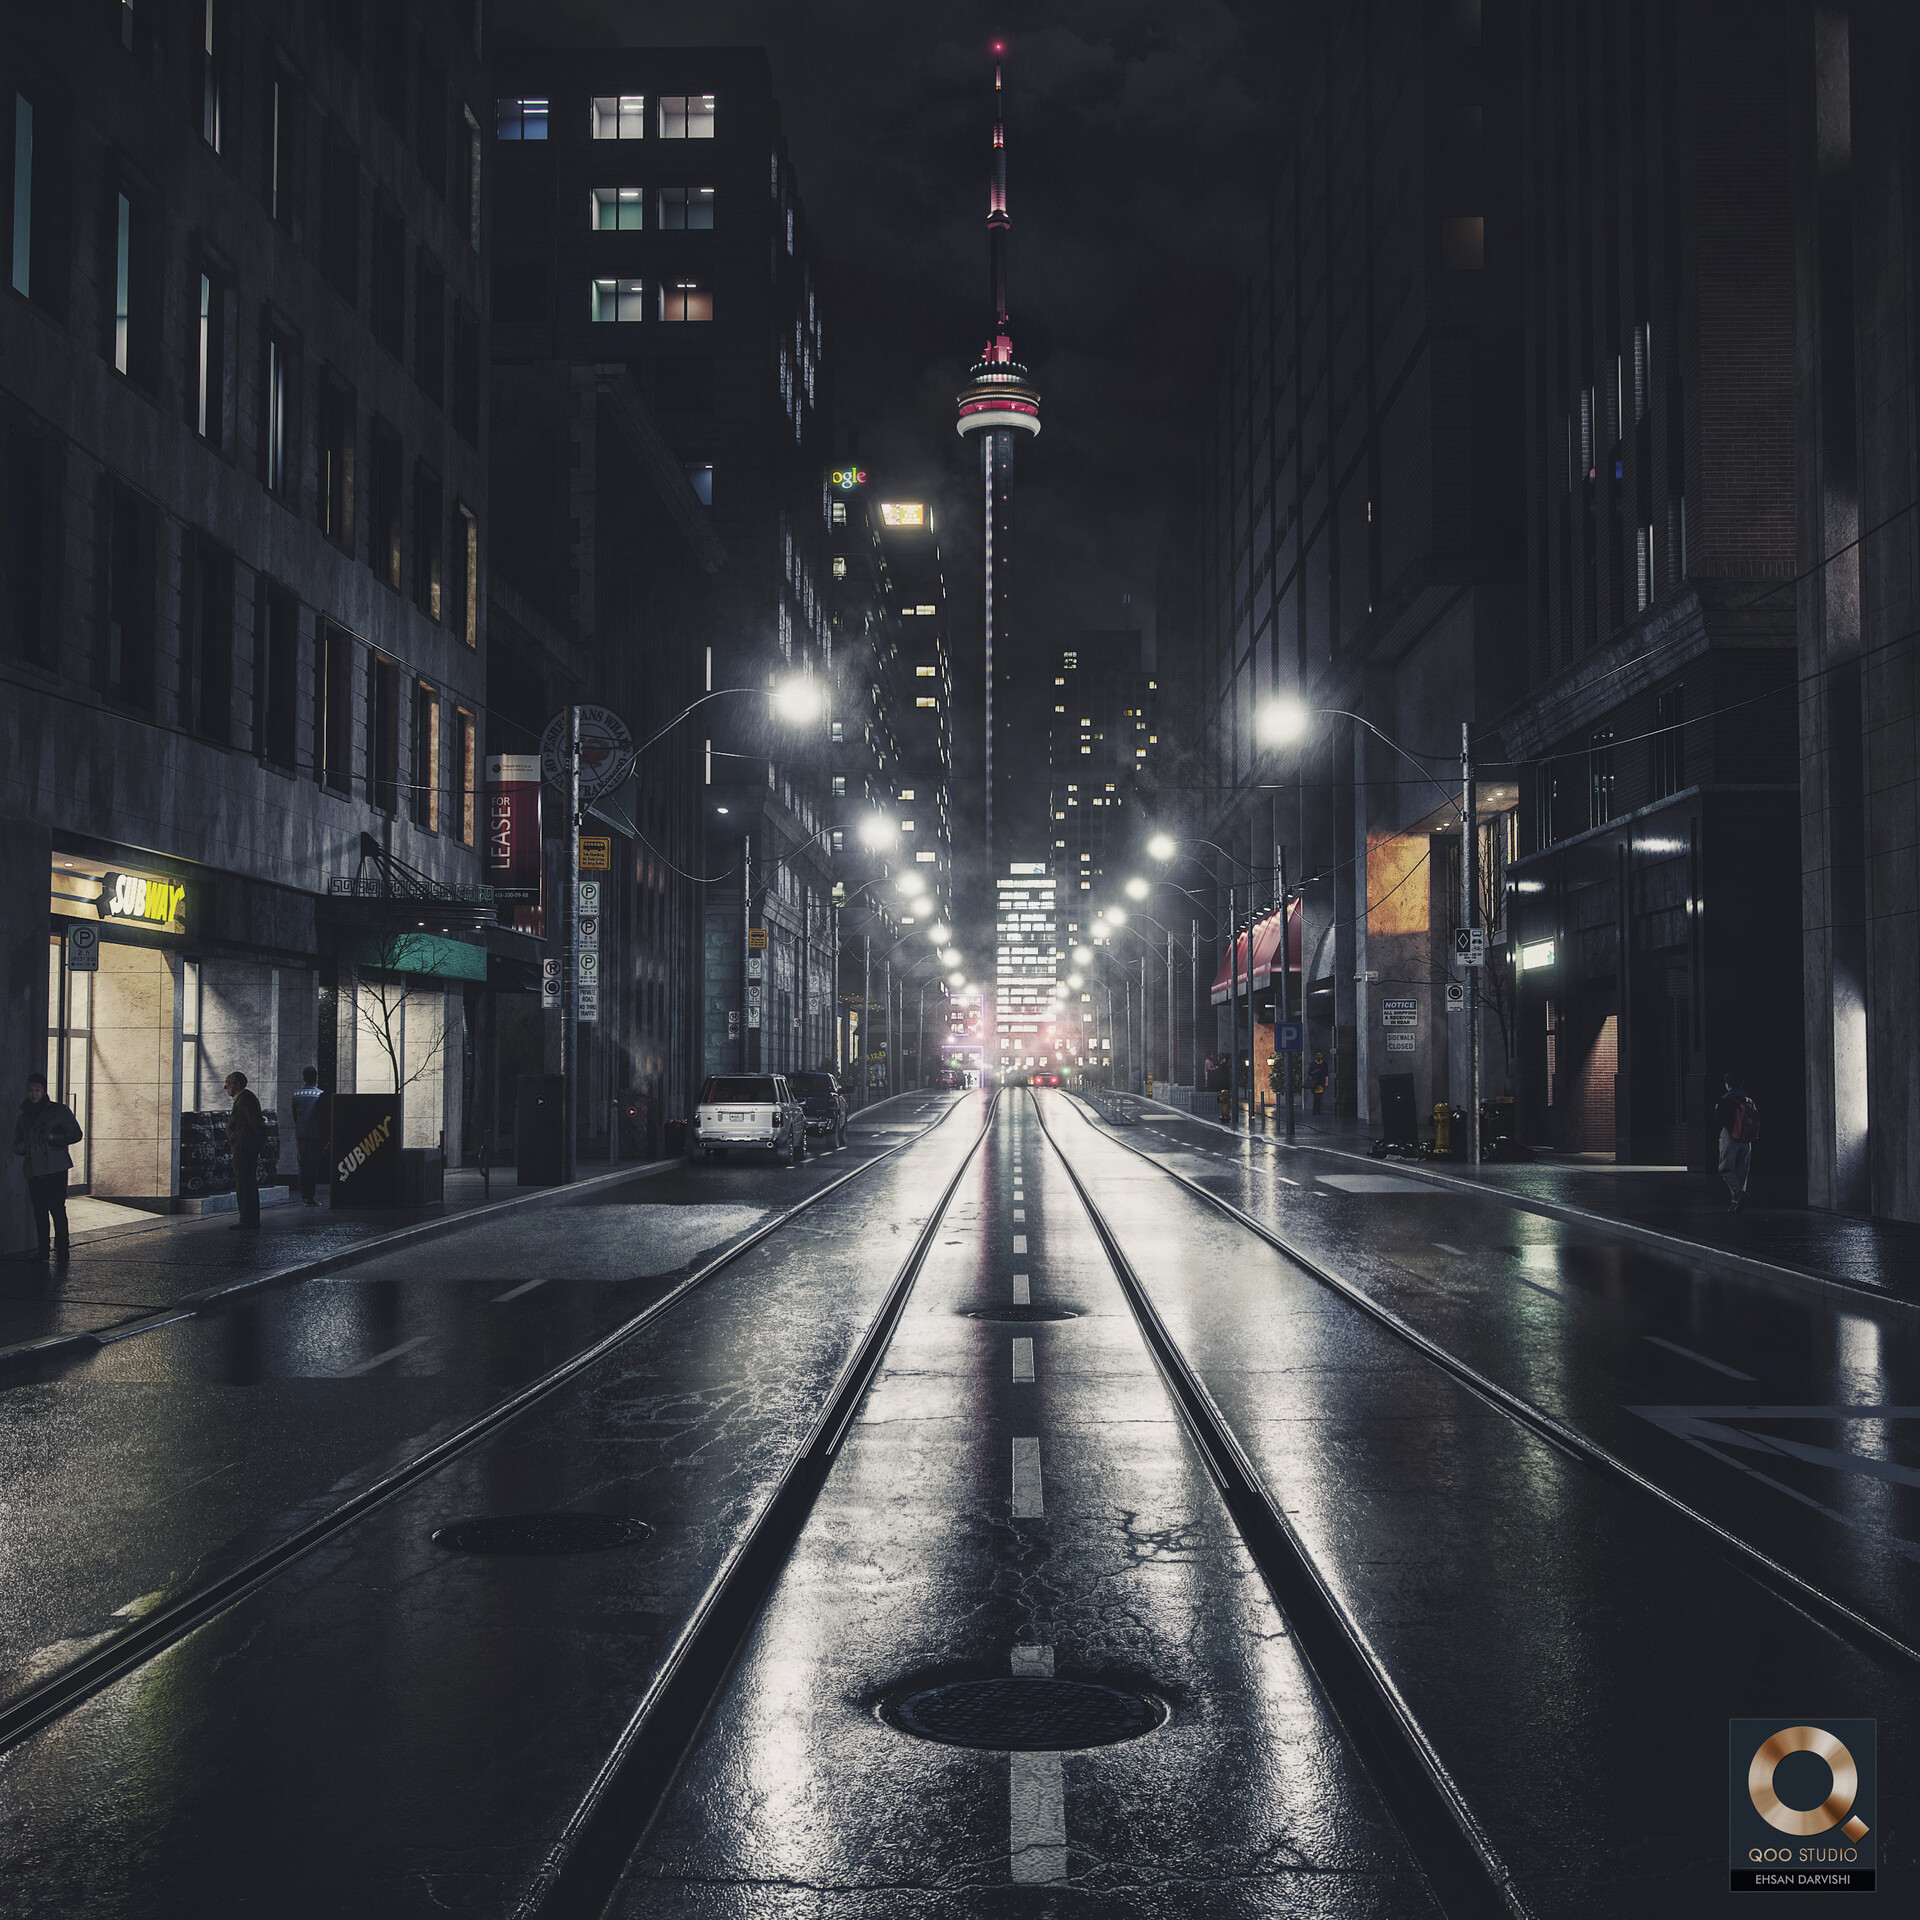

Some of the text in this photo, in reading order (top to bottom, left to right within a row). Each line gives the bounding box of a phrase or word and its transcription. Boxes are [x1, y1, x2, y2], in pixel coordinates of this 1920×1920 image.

[491, 797, 511, 806] FOR
[490, 806, 511, 869] LEASE
[109, 874, 186, 922] SUBWAY
[585, 887, 593, 896] P
[585, 922, 593, 931] P
[80, 931, 90, 944] P
[585, 957, 593, 967] P
[1281, 1027, 1298, 1048] P
[337, 1115, 391, 1182] SUBWAY
